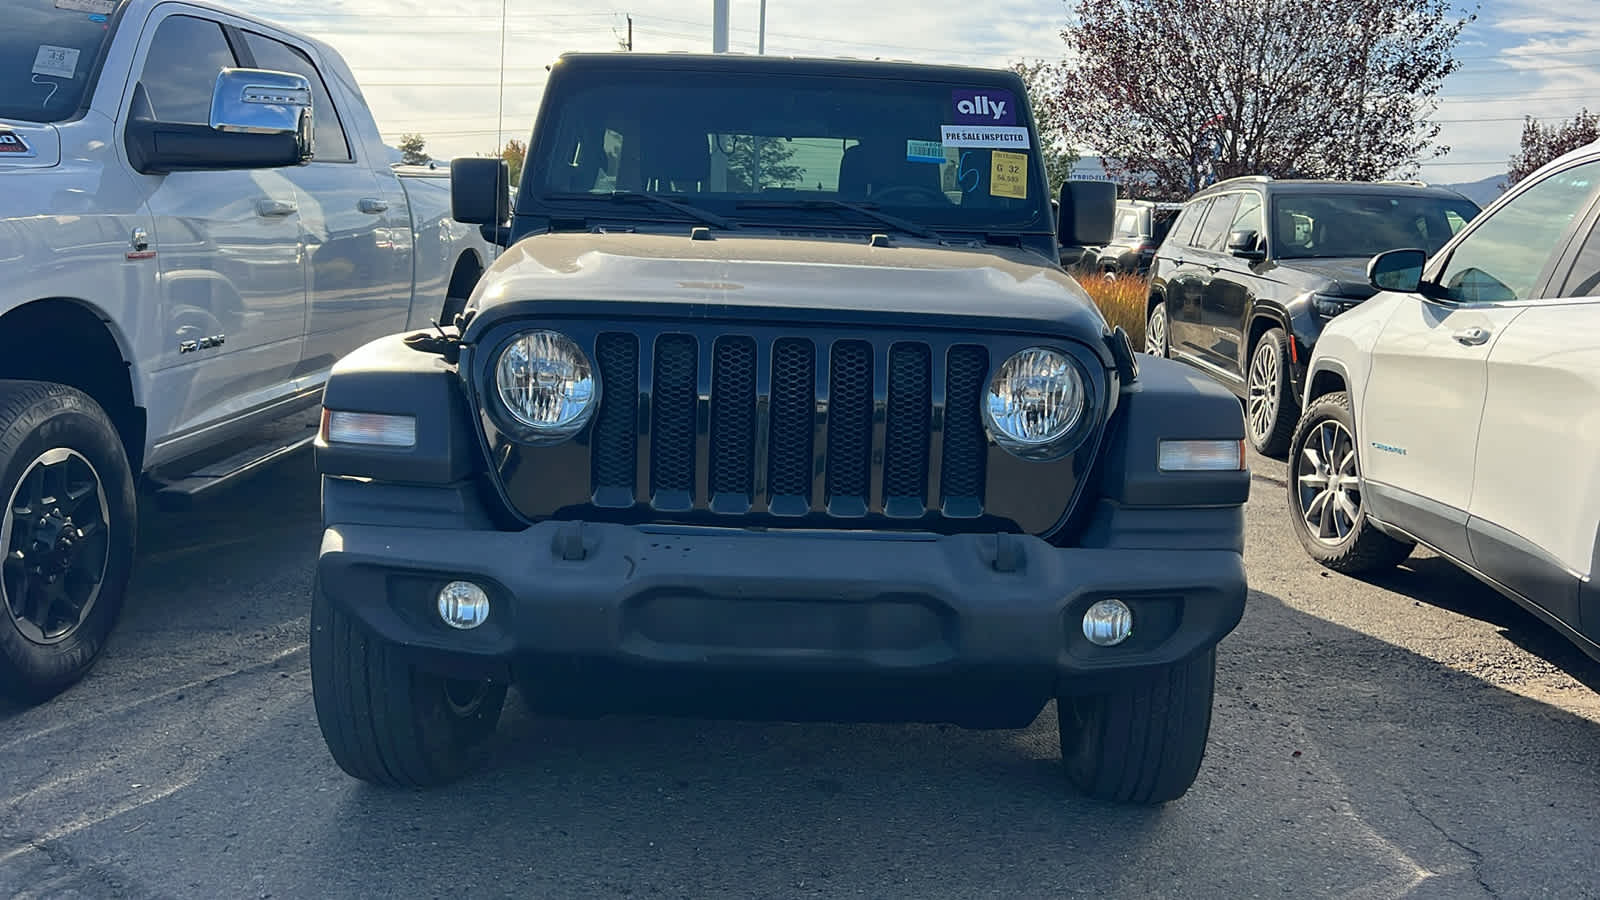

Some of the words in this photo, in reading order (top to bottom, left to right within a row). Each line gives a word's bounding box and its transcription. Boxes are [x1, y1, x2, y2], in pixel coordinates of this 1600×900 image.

[957, 95, 1006, 120] ally
[945, 132, 961, 141] PRE
[962, 132, 980, 141] SALE
[981, 133, 1024, 142] INSPECTED
[1008, 165, 1020, 174] 32
